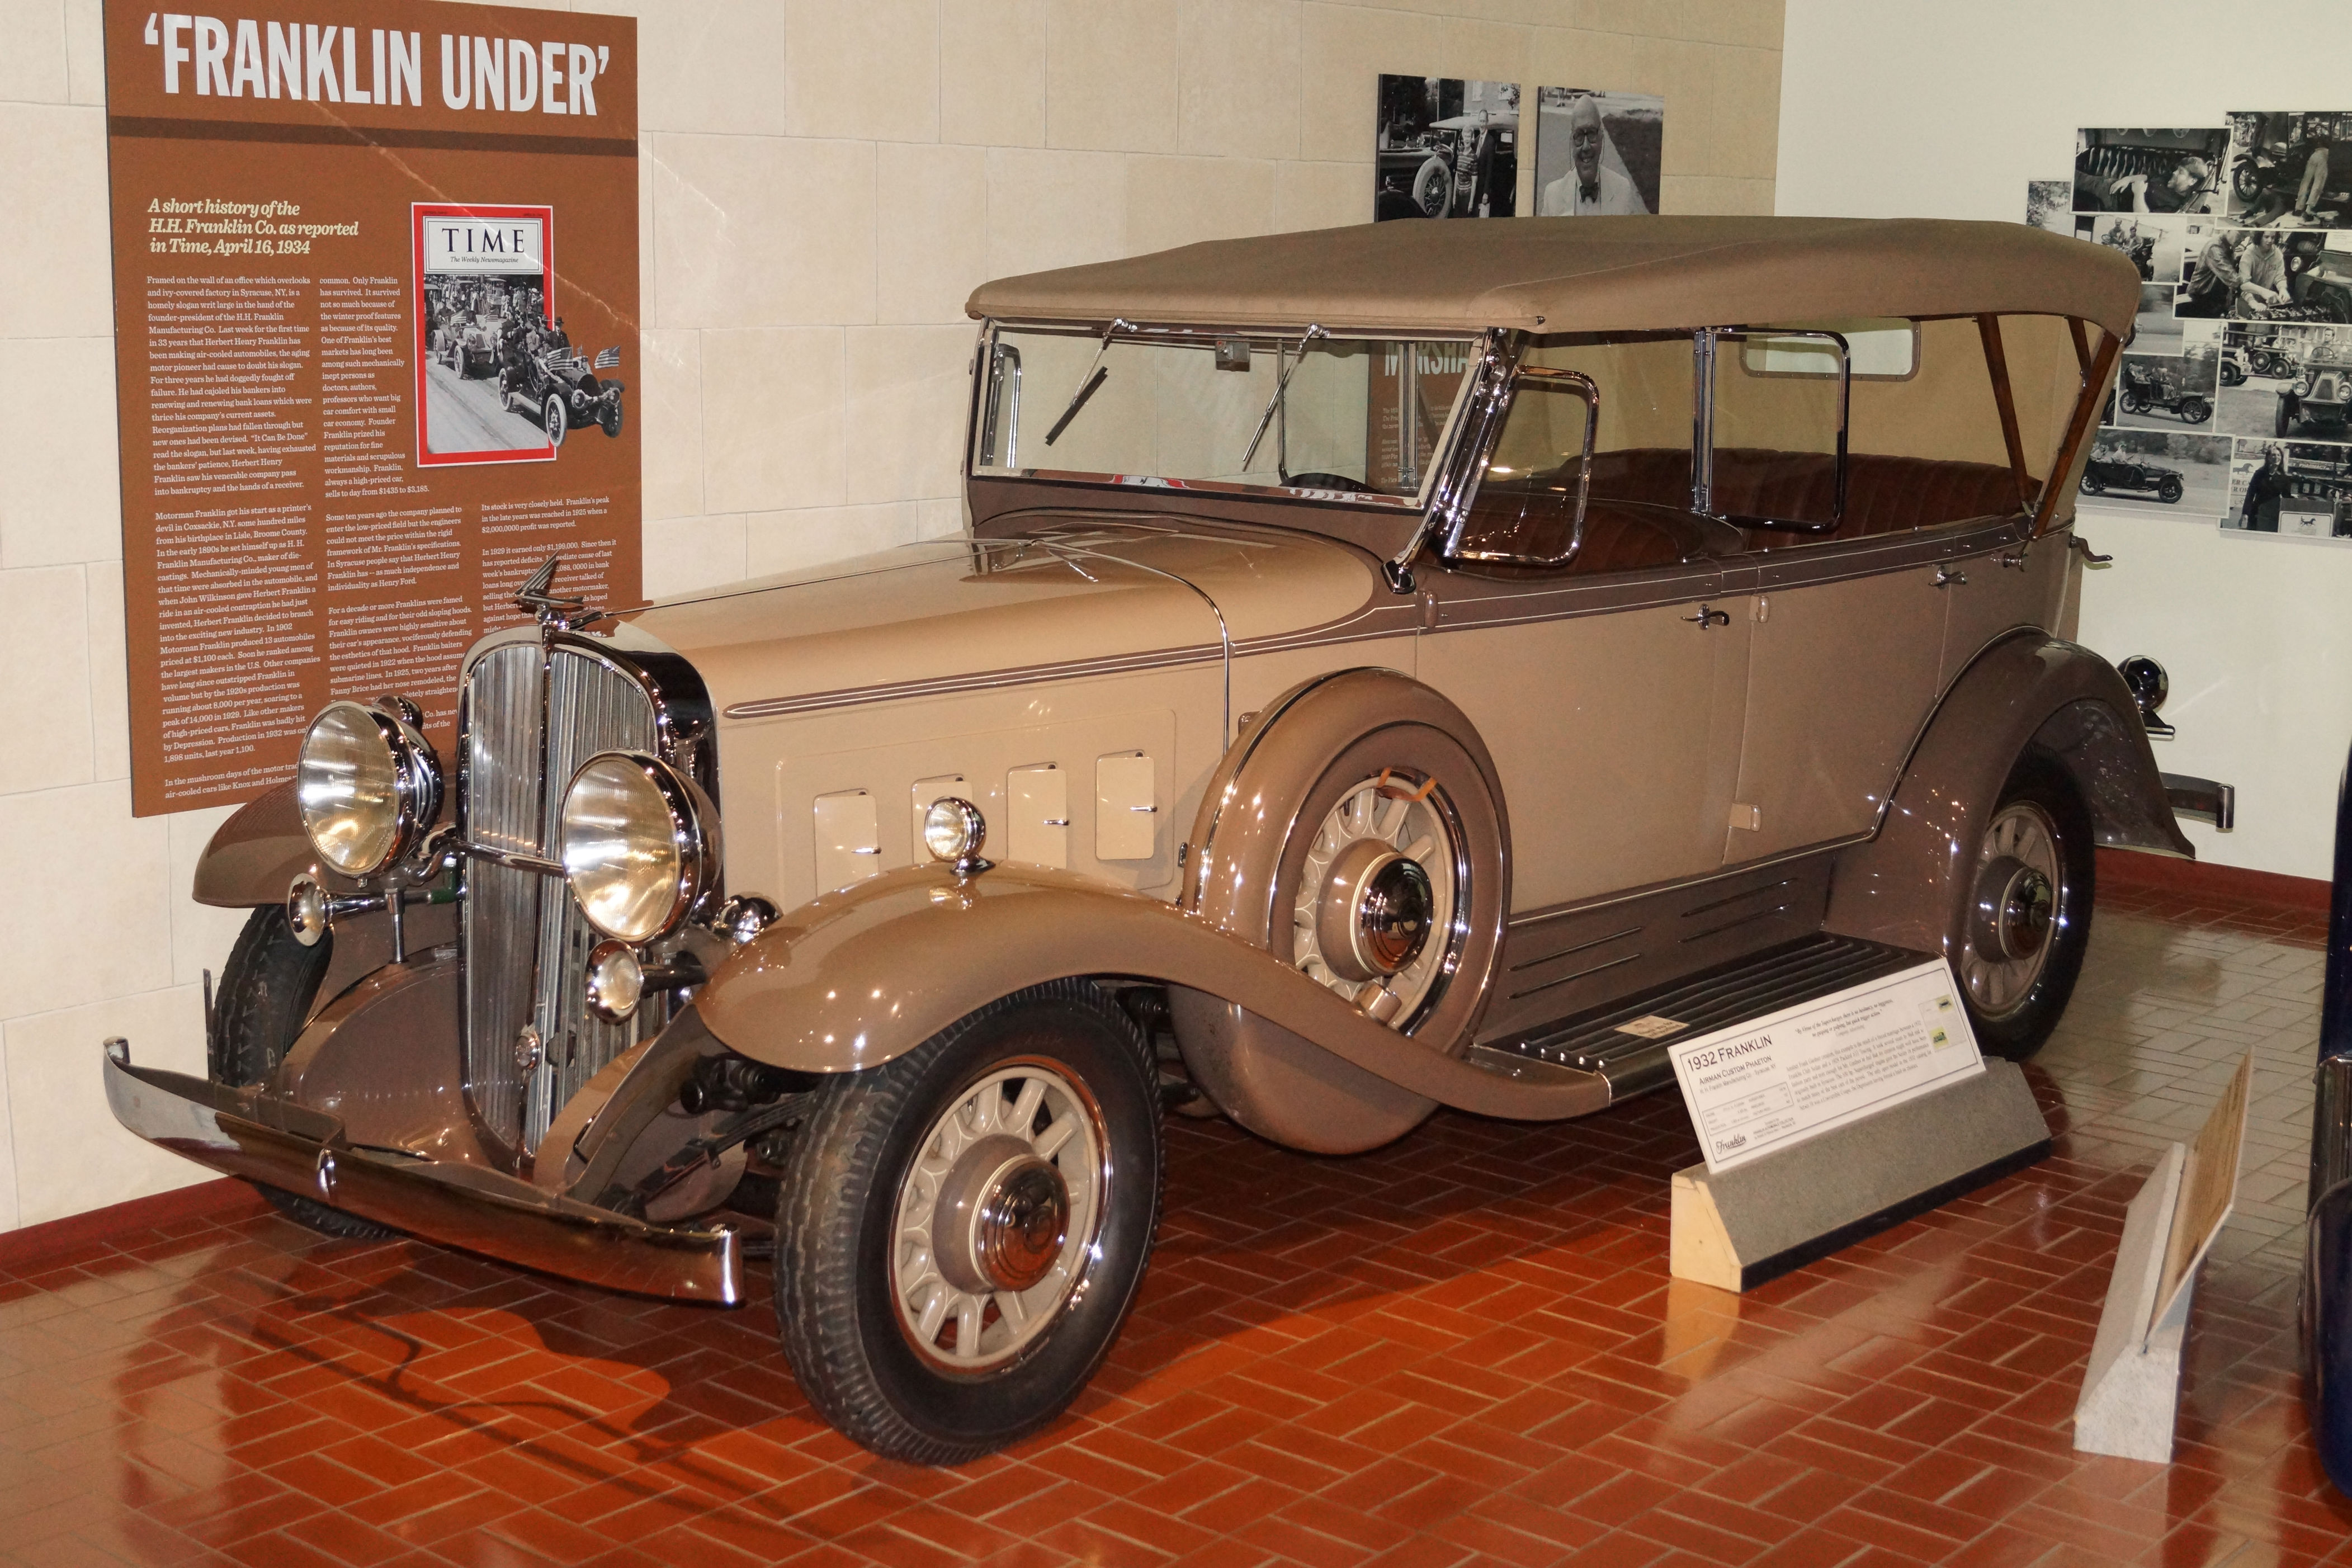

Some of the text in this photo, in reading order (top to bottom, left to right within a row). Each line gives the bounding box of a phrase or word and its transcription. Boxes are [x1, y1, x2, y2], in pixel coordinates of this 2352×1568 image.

[148, 198, 300, 218] A short history of the
[149, 218, 359, 238] H.H. Franklin Co. as reported
[150, 238, 311, 256] in Time, April 16, 1934
[442, 228, 525, 253] TIME
[352, 277, 369, 286] Only
[162, 289, 205, 297] ivy-covered
[205, 289, 231, 297] factory
[148, 313, 214, 323] founder-president
[356, 312, 375, 321] proof
[149, 325, 204, 335] Manufacturing
[234, 337, 257, 347] Henry
[490, 502, 508, 511] stock
[528, 499, 550, 509] closely
[596, 496, 610, 506] peak
[155, 510, 194, 519] Motorman
[195, 508, 226, 517] Franklin
[226, 508, 238, 517] got
[325, 512, 345, 521] Some
[399, 509, 428, 518] company
[429, 506, 455, 517] planned
[512, 514, 528, 522] years
[541, 510, 565, 518] reached
[572, 508, 587, 517] 1925
[587, 507, 603, 516] when
[326, 525, 344, 533] enter
[356, 522, 393, 533] low-priced
[391, 521, 407, 529] field
[431, 518, 461, 528] engineers
[520, 523, 537, 533] profit
[205, 749, 219, 758] last
[219, 749, 235, 758] year
[165, 778, 173, 787] In
[174, 777, 186, 786] the
[187, 772, 225, 784] mushroom
[226, 770, 242, 781] days
[251, 767, 262, 776] the
[263, 764, 284, 774] motor
[1688, 1035, 1773, 1071] 1932 FRANKLIN
[1699, 1056, 1772, 1085] AIRMAN CUSTOM PHAETON
[1716, 1133, 1747, 1154] Franklin
